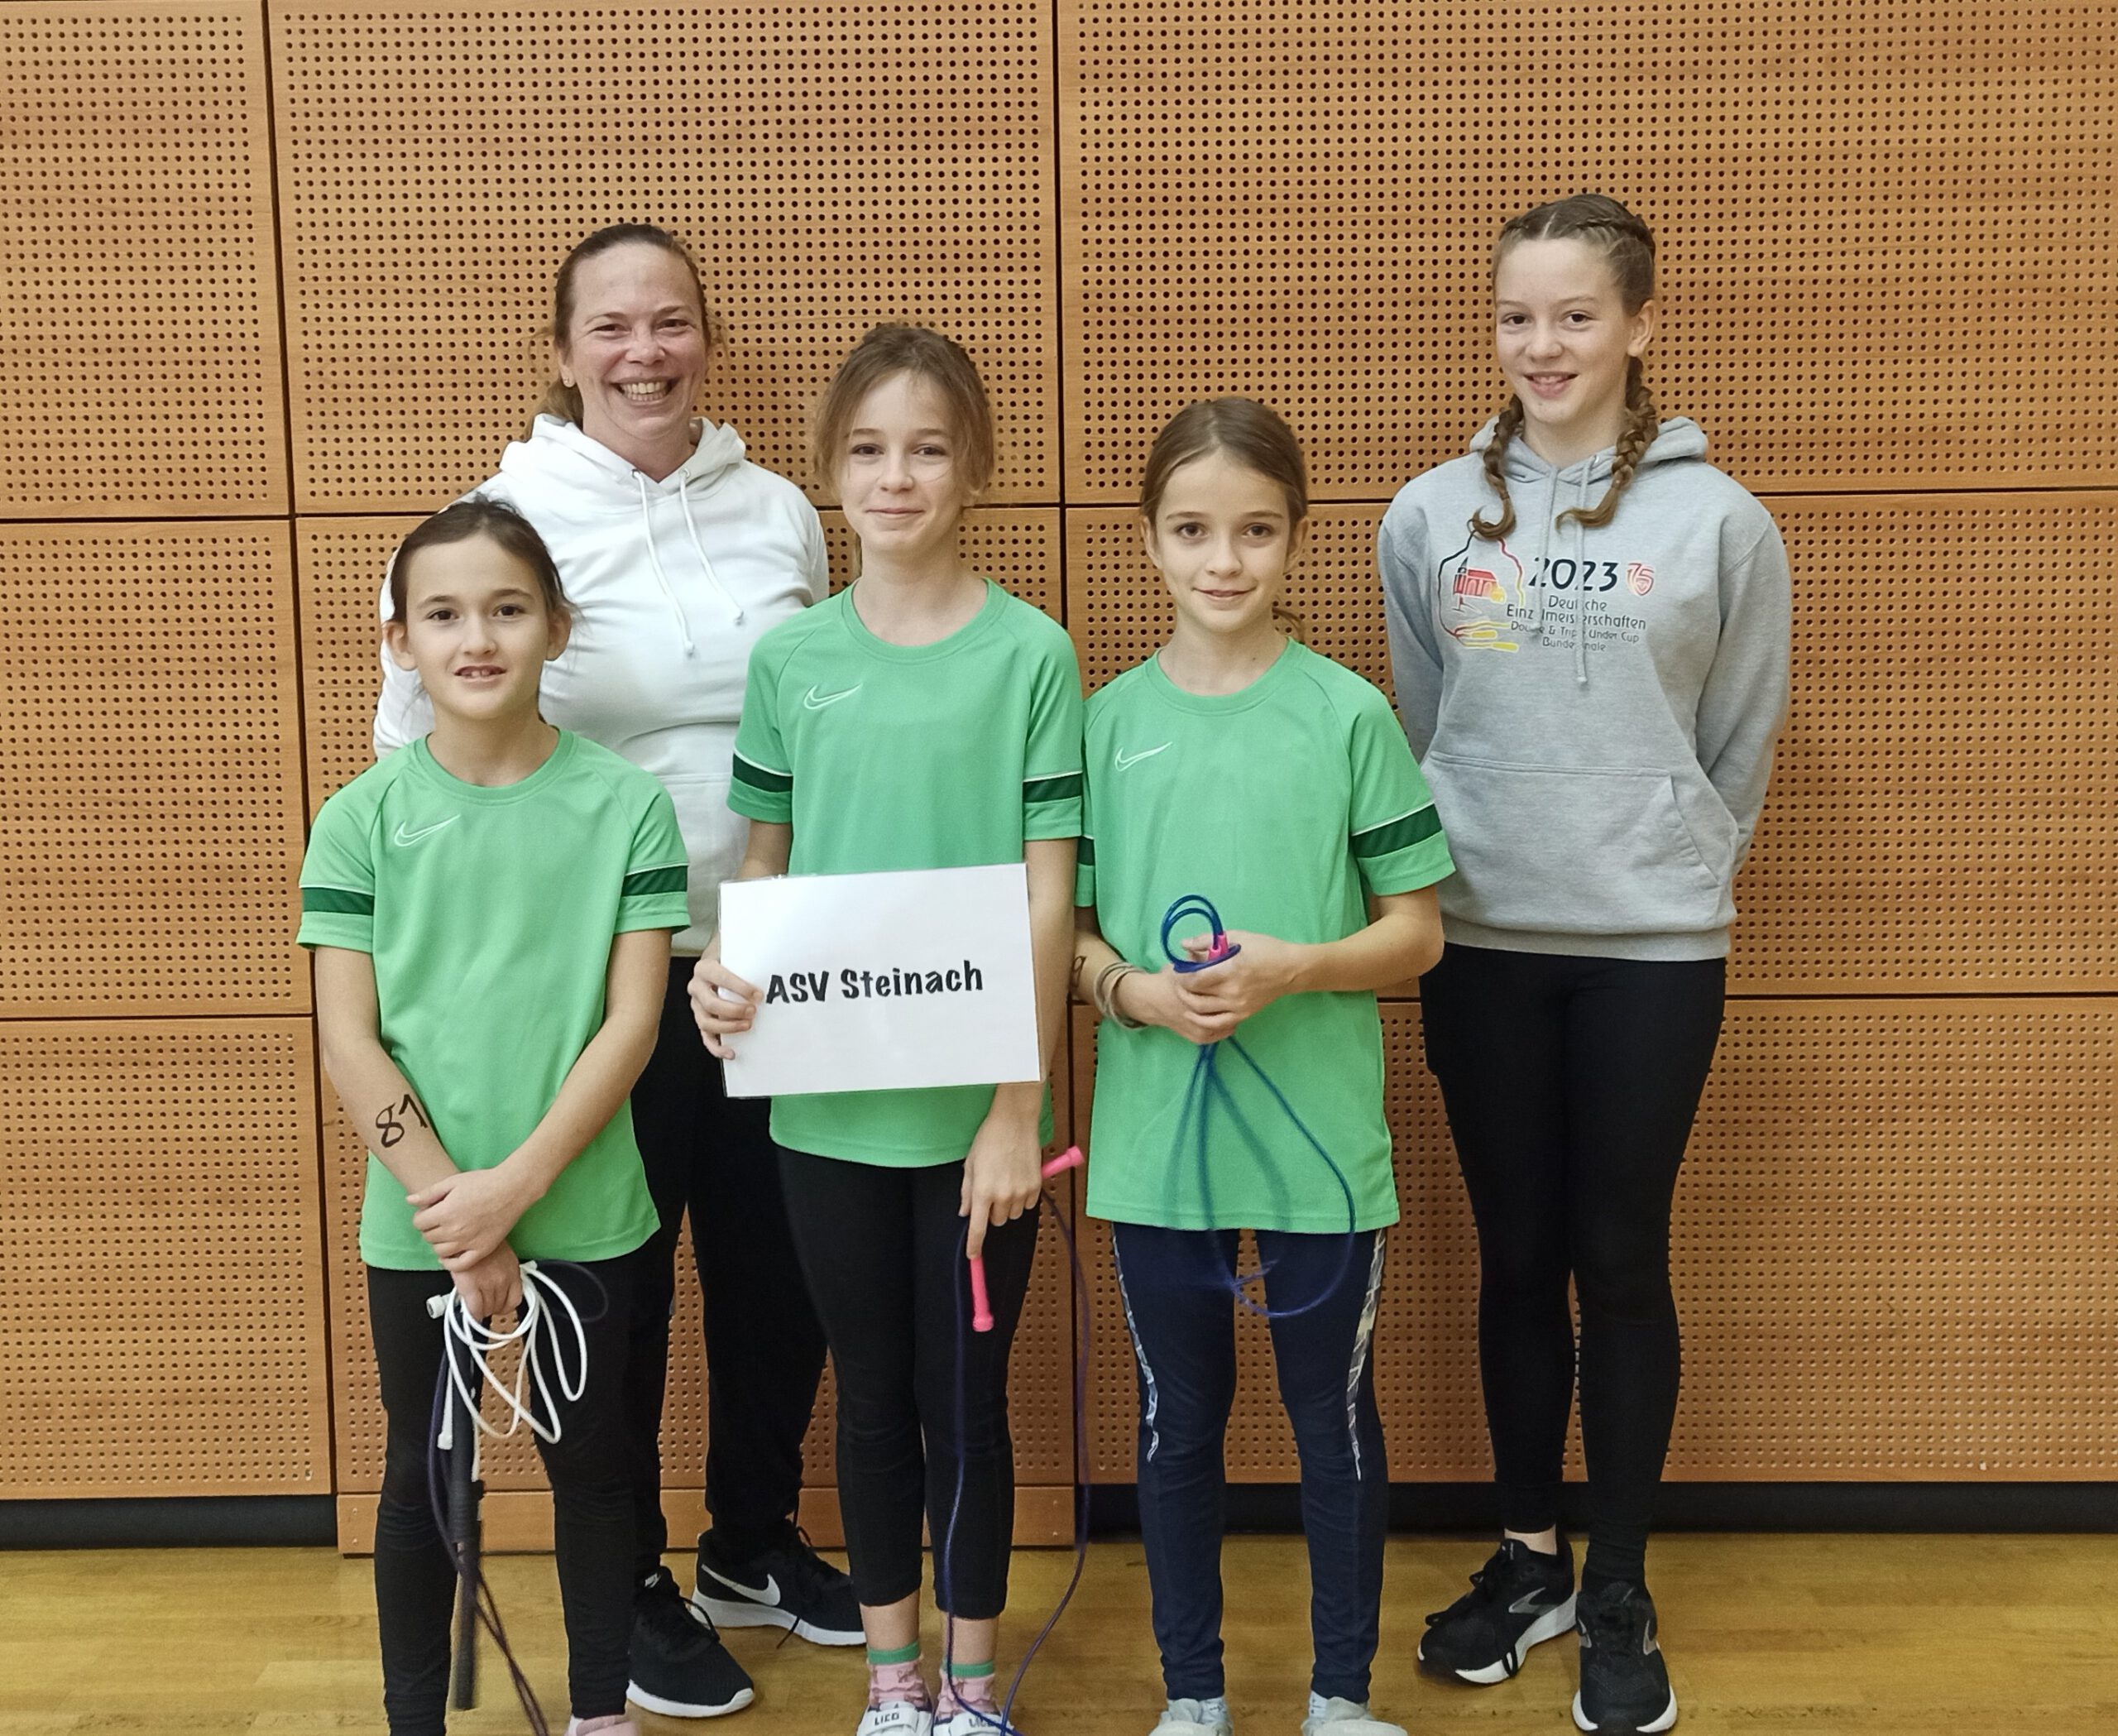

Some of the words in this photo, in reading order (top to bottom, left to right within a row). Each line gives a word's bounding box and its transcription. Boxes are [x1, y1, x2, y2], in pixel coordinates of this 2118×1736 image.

[1528, 557, 1618, 592] 2023
[1549, 595, 1608, 611] Deutche
[1507, 603, 1646, 631] Einzlmeiserschaften
[1511, 621, 1545, 634] Doue
[1560, 626, 1586, 638] Trip
[1588, 629, 1617, 640] Under
[1621, 631, 1640, 644] Cup
[1542, 636, 1607, 652] Bundenale
[765, 971, 829, 1004] ASV
[840, 960, 984, 999] Steinach
